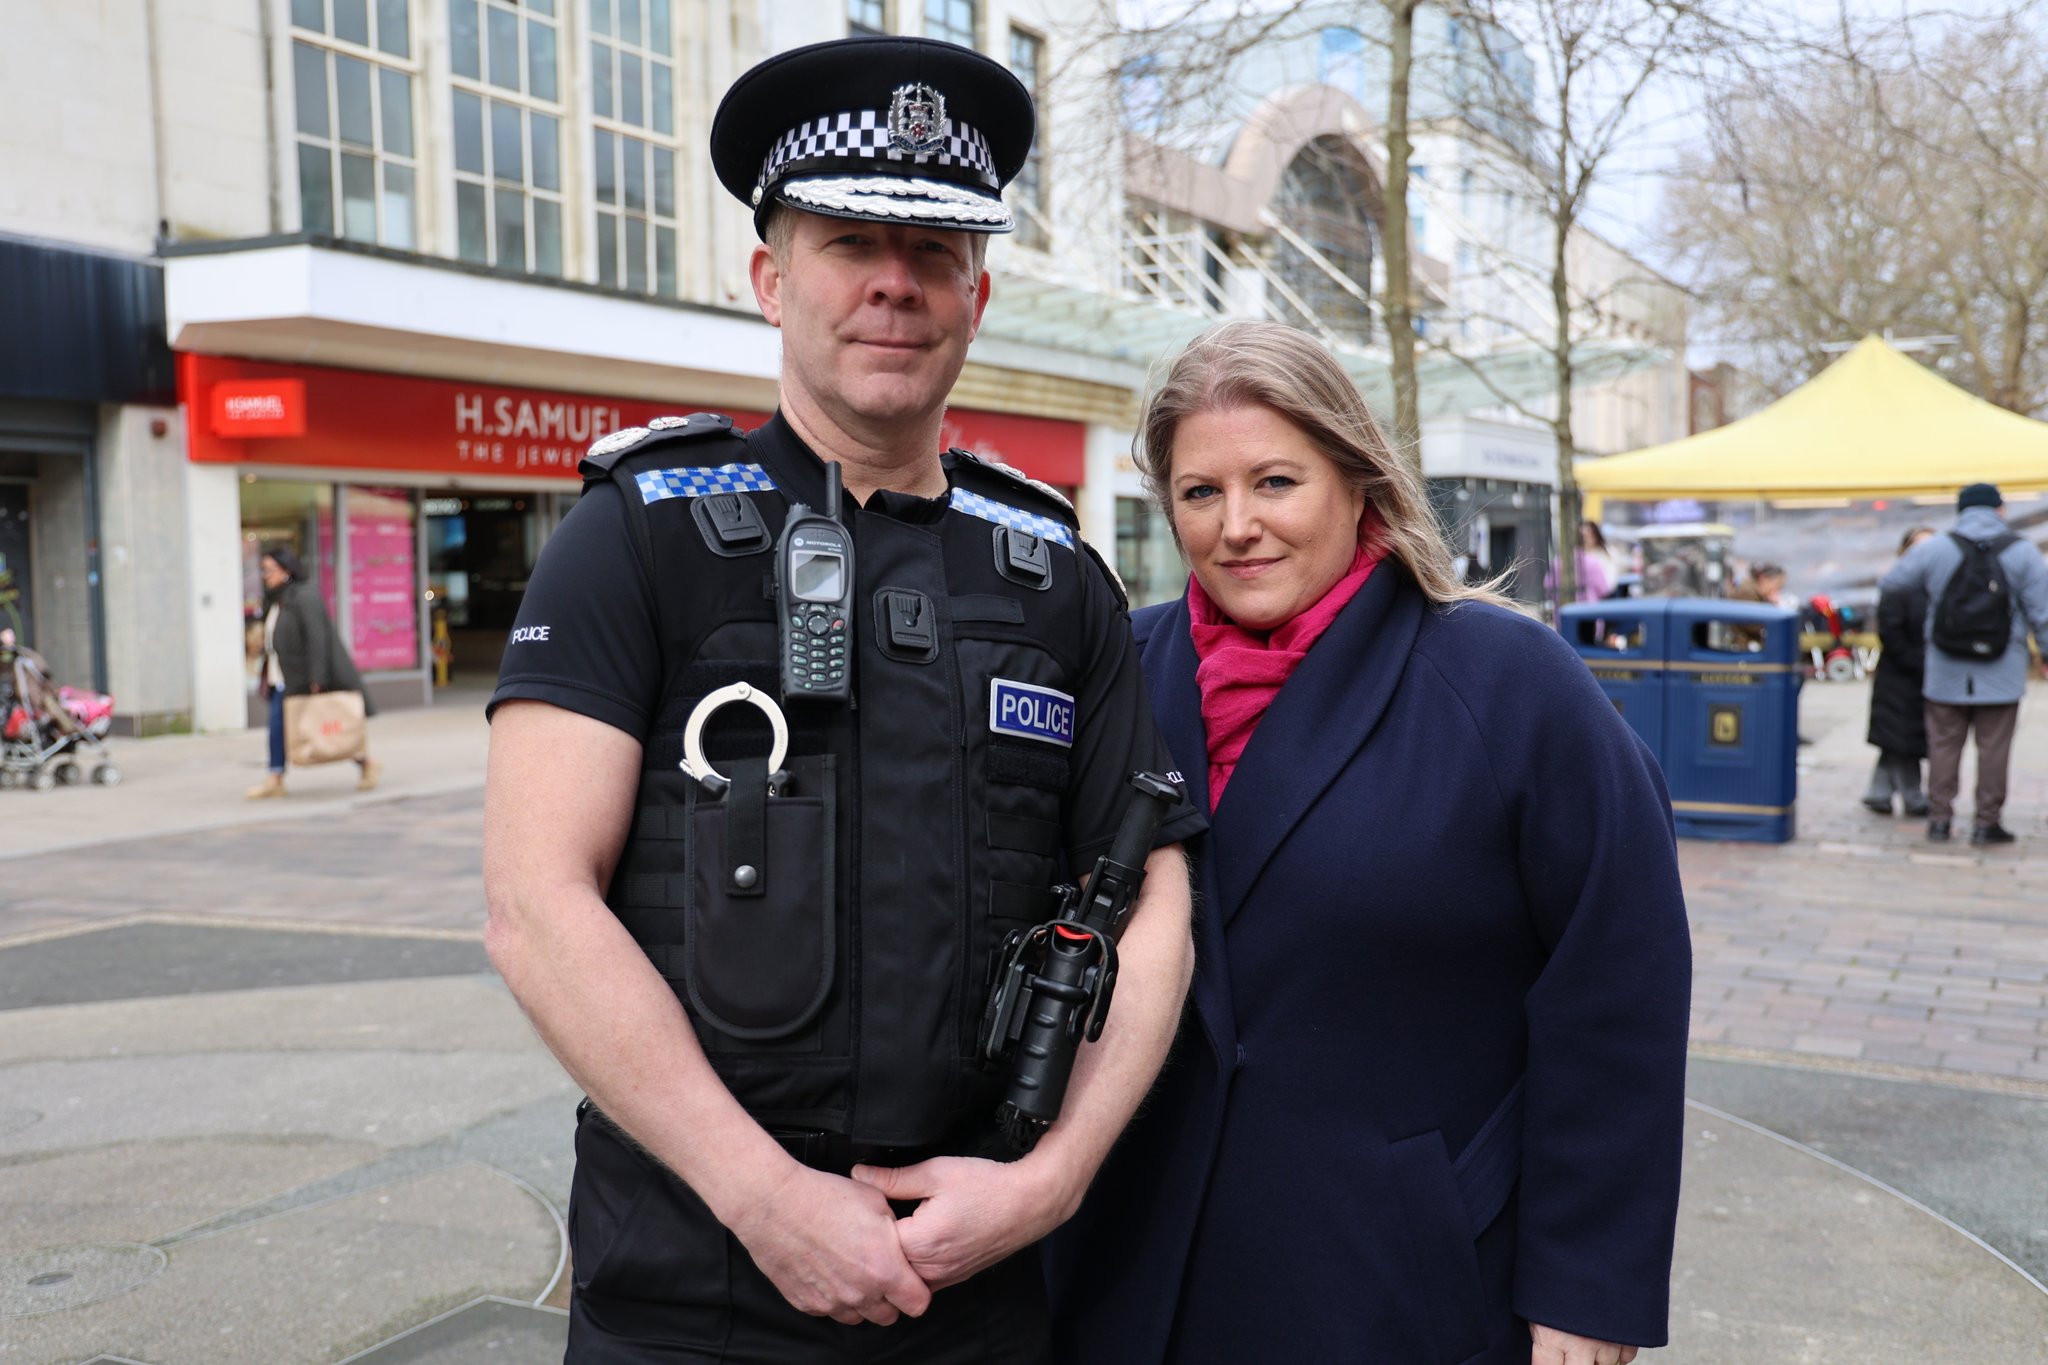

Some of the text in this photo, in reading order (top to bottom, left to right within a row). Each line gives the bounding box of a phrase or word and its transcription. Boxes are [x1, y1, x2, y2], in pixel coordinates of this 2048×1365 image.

[456, 440, 504, 464] THE
[512, 626, 551, 645] POLICE
[1002, 693, 1070, 736] POLICE
